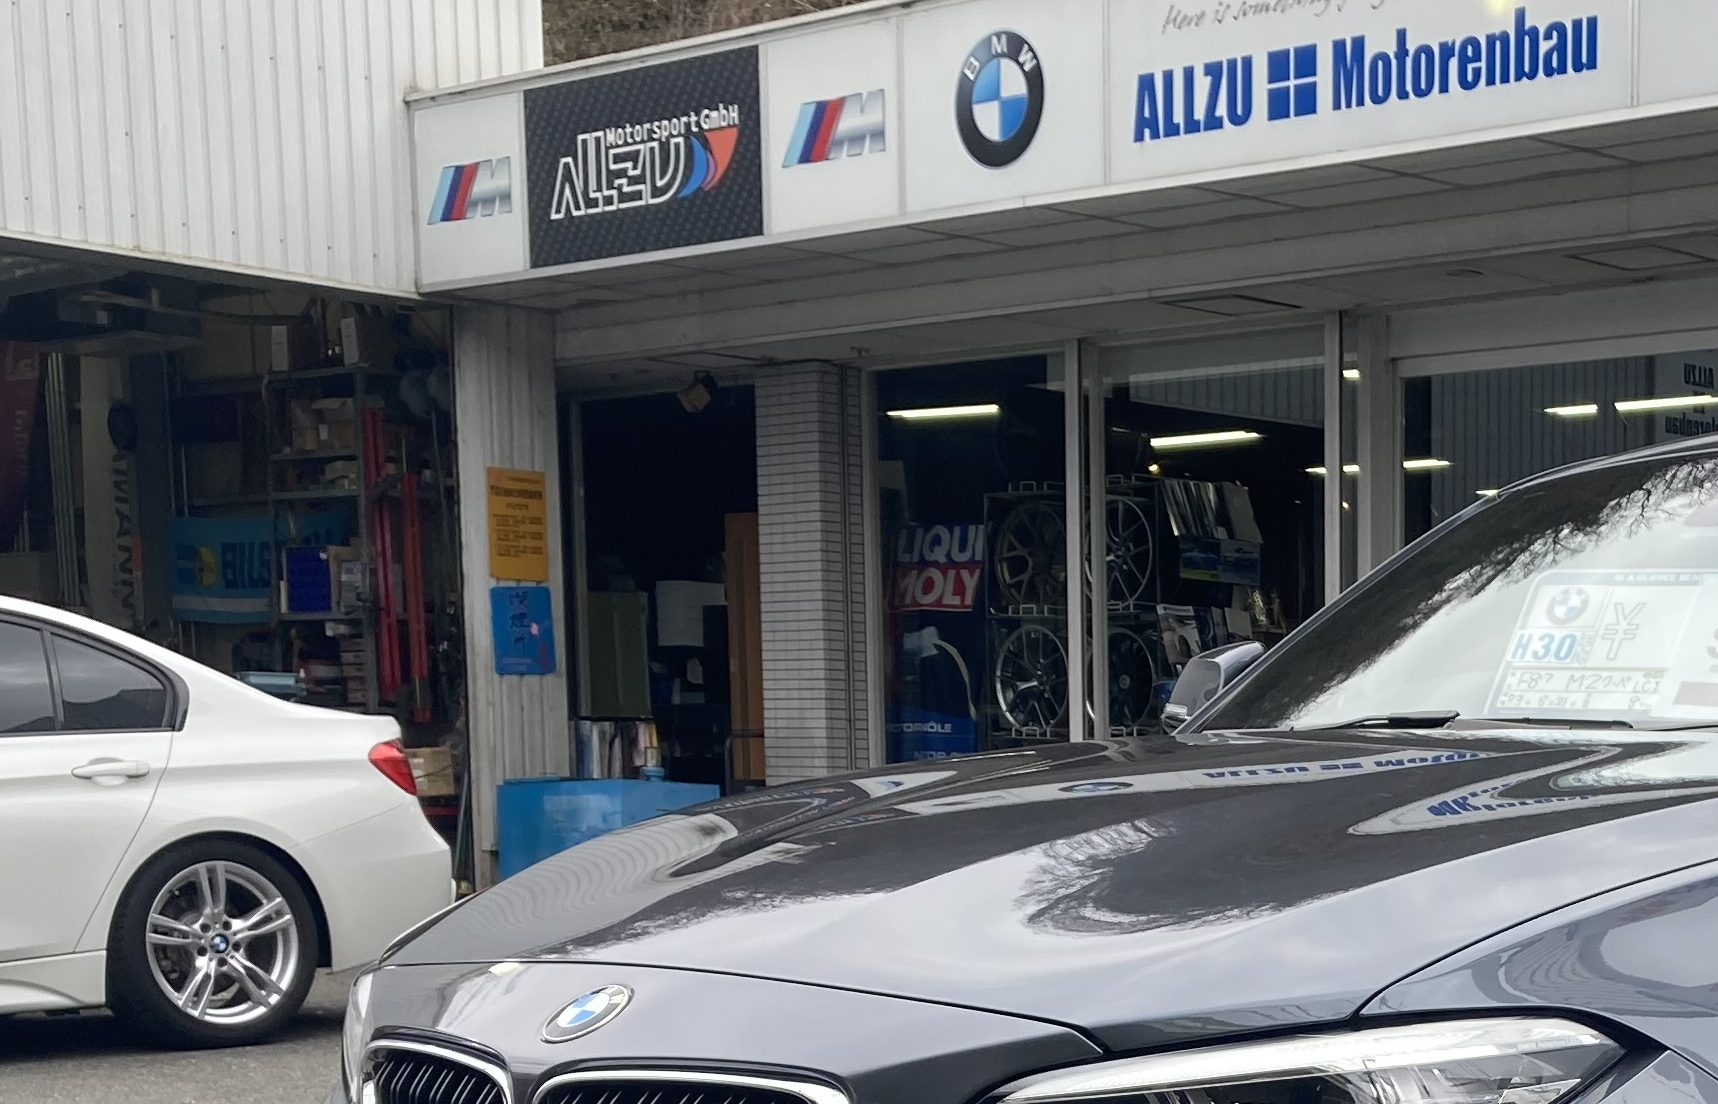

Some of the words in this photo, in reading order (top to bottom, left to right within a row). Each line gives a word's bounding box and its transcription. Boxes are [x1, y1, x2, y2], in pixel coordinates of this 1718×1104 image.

[961, 32, 1040, 82] BMW
[1133, 54, 1254, 143] ALLZU
[1331, 6, 1599, 111] Motorenbau
[605, 112, 699, 147] Motorsport
[699, 103, 740, 131] GmbH
[894, 566, 983, 607] MOLY
[1510, 632, 1577, 661] H30
